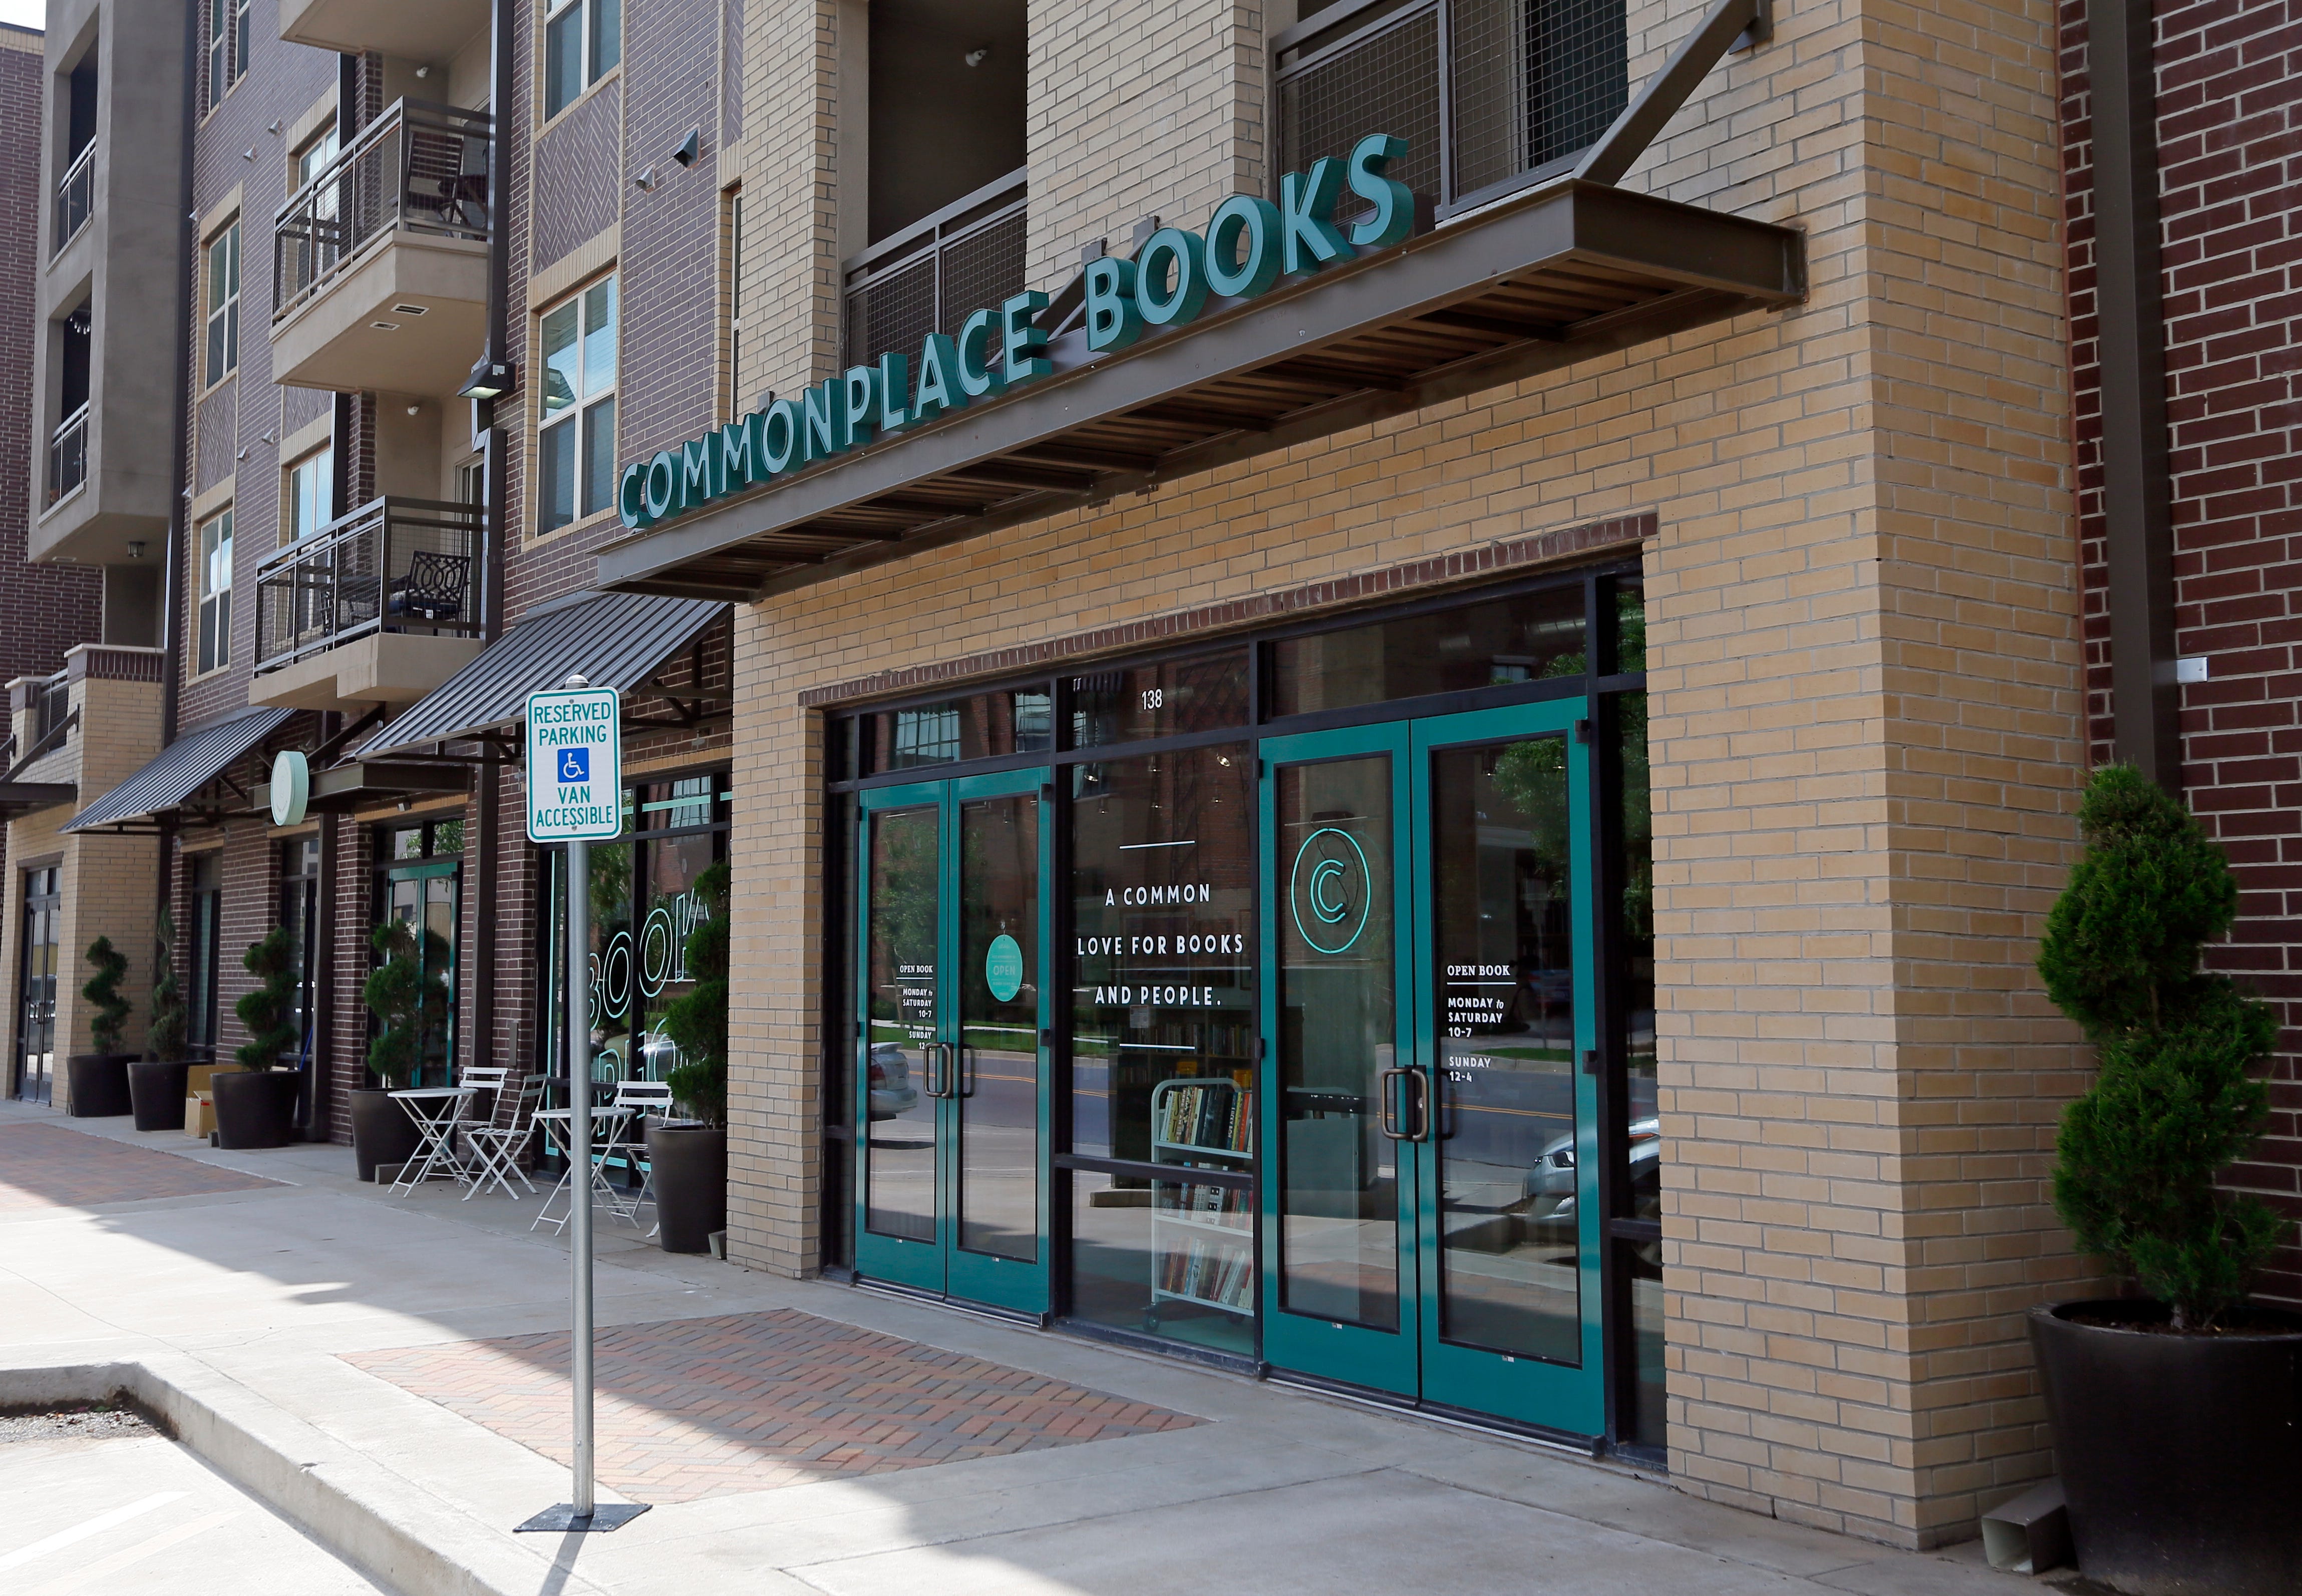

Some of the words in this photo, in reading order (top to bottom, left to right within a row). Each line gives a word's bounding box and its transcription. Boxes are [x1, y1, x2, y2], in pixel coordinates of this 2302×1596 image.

[619, 290, 1050, 529] COMMONPLACE
[1084, 133, 1414, 353] BOOKS
[1141, 689, 1162, 710] 138
[534, 702, 611, 724] RESERVED
[539, 725, 607, 746] PARKING
[557, 785, 590, 805] VAN
[535, 805, 613, 828] ACCESSIBLE
[1105, 888, 1115, 906] A
[1123, 883, 1210, 905] COMMON
[1078, 937, 1122, 955] LOVE
[1132, 936, 1167, 954] FOR
[1176, 934, 1243, 954] BOOKS
[899, 965, 915, 973] OPEN
[916, 965, 933, 973] BOOK
[993, 966, 1016, 976] OPEN
[1447, 965, 1475, 976] OPEN
[1478, 965, 1511, 976] BOOK
[903, 988, 927, 996] MONDAY
[1095, 986, 1131, 1004] AND
[1140, 986, 1221, 1006] PEOPLE.
[903, 999, 932, 1007] SATURDAY
[1448, 997, 1493, 1008] MONDAY
[1496, 999, 1504, 1010] to
[918, 1010, 932, 1018] 10-7
[1448, 1012, 1503, 1023] SATURDAY
[909, 1031, 932, 1039] SUNDAY
[1448, 1027, 1472, 1038] 10-7
[1449, 1056, 1491, 1069] SUNDAY
[1449, 1071, 1472, 1083] 12-4
